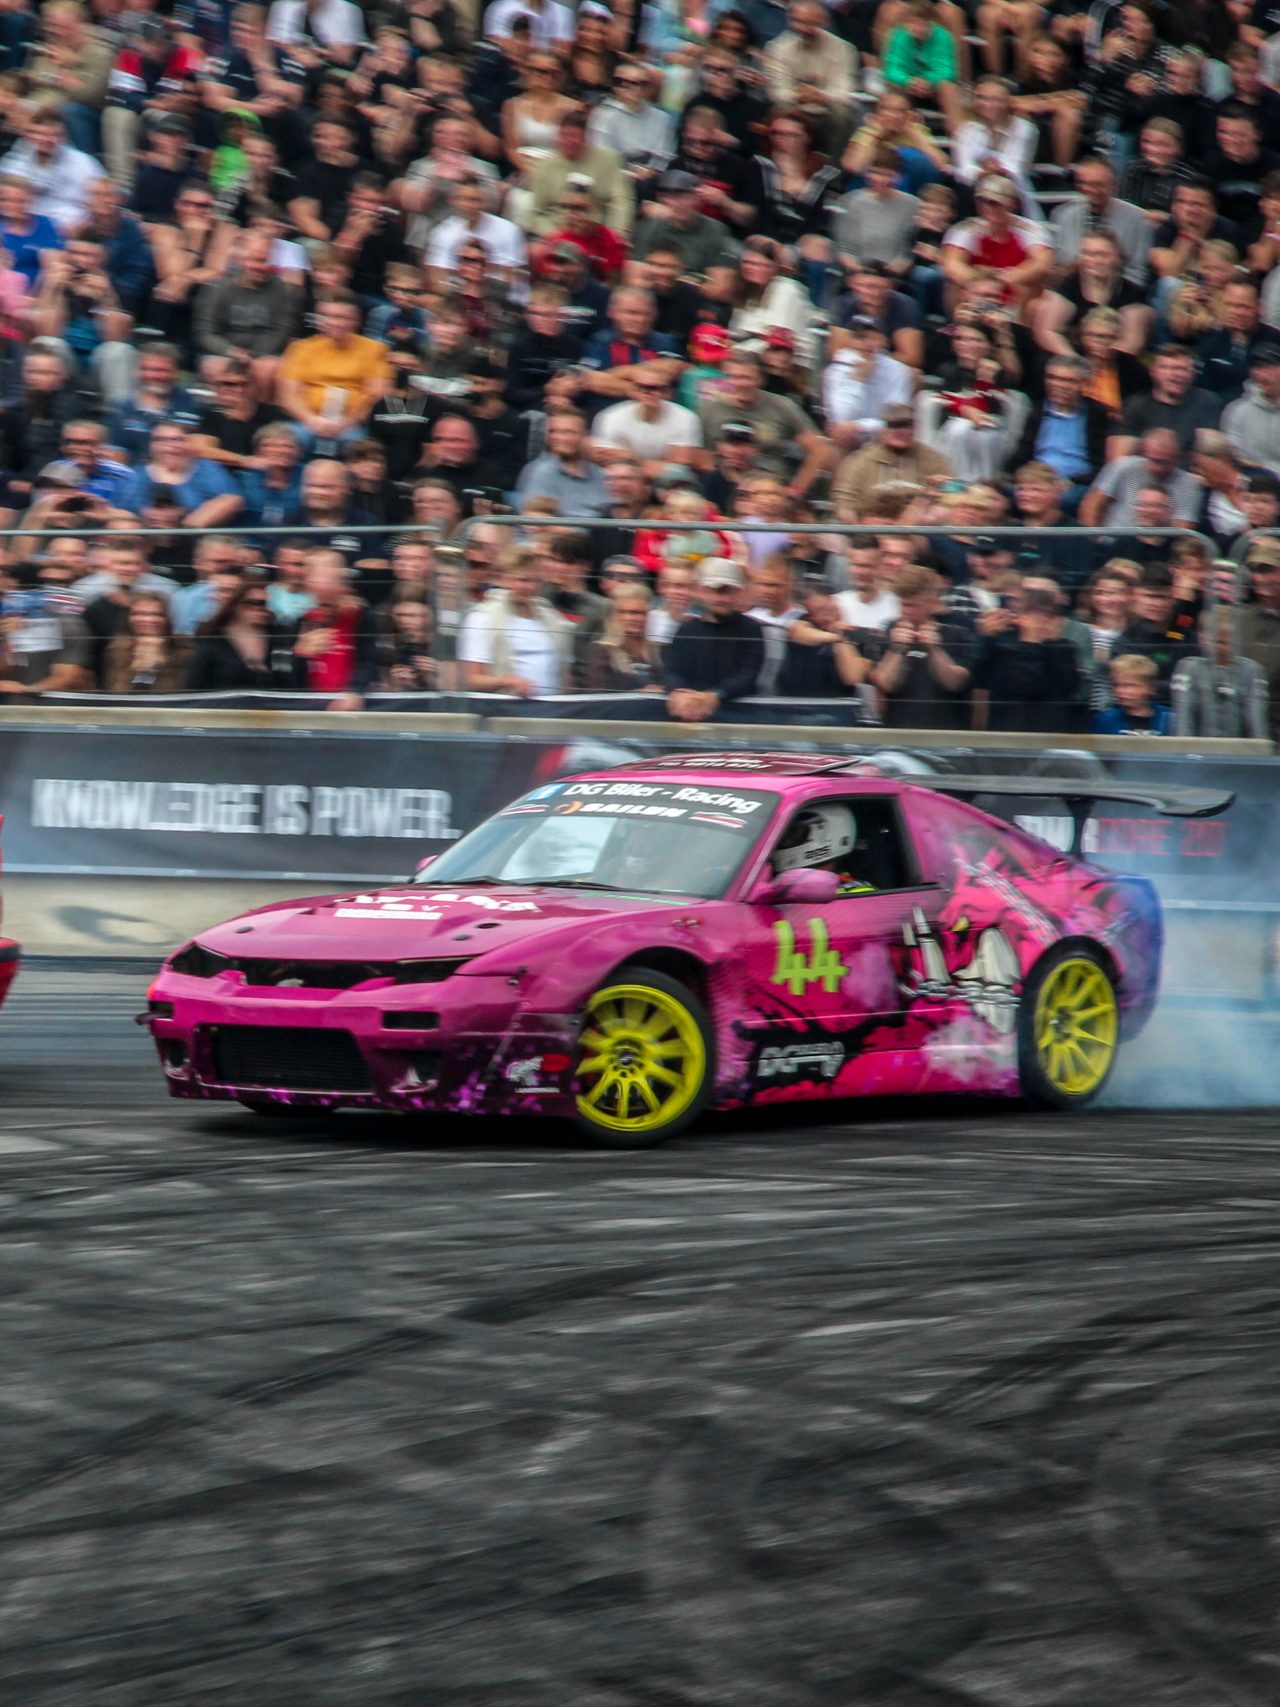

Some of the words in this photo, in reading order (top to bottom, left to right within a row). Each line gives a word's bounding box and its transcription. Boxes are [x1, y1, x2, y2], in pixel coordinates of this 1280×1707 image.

[31, 779, 261, 834] KNOWLEDGE
[263, 784, 310, 836] IS
[563, 784, 602, 796] DG
[672, 787, 762, 813] Racing
[578, 803, 690, 817] SAILUN
[772, 917, 849, 995] 44
